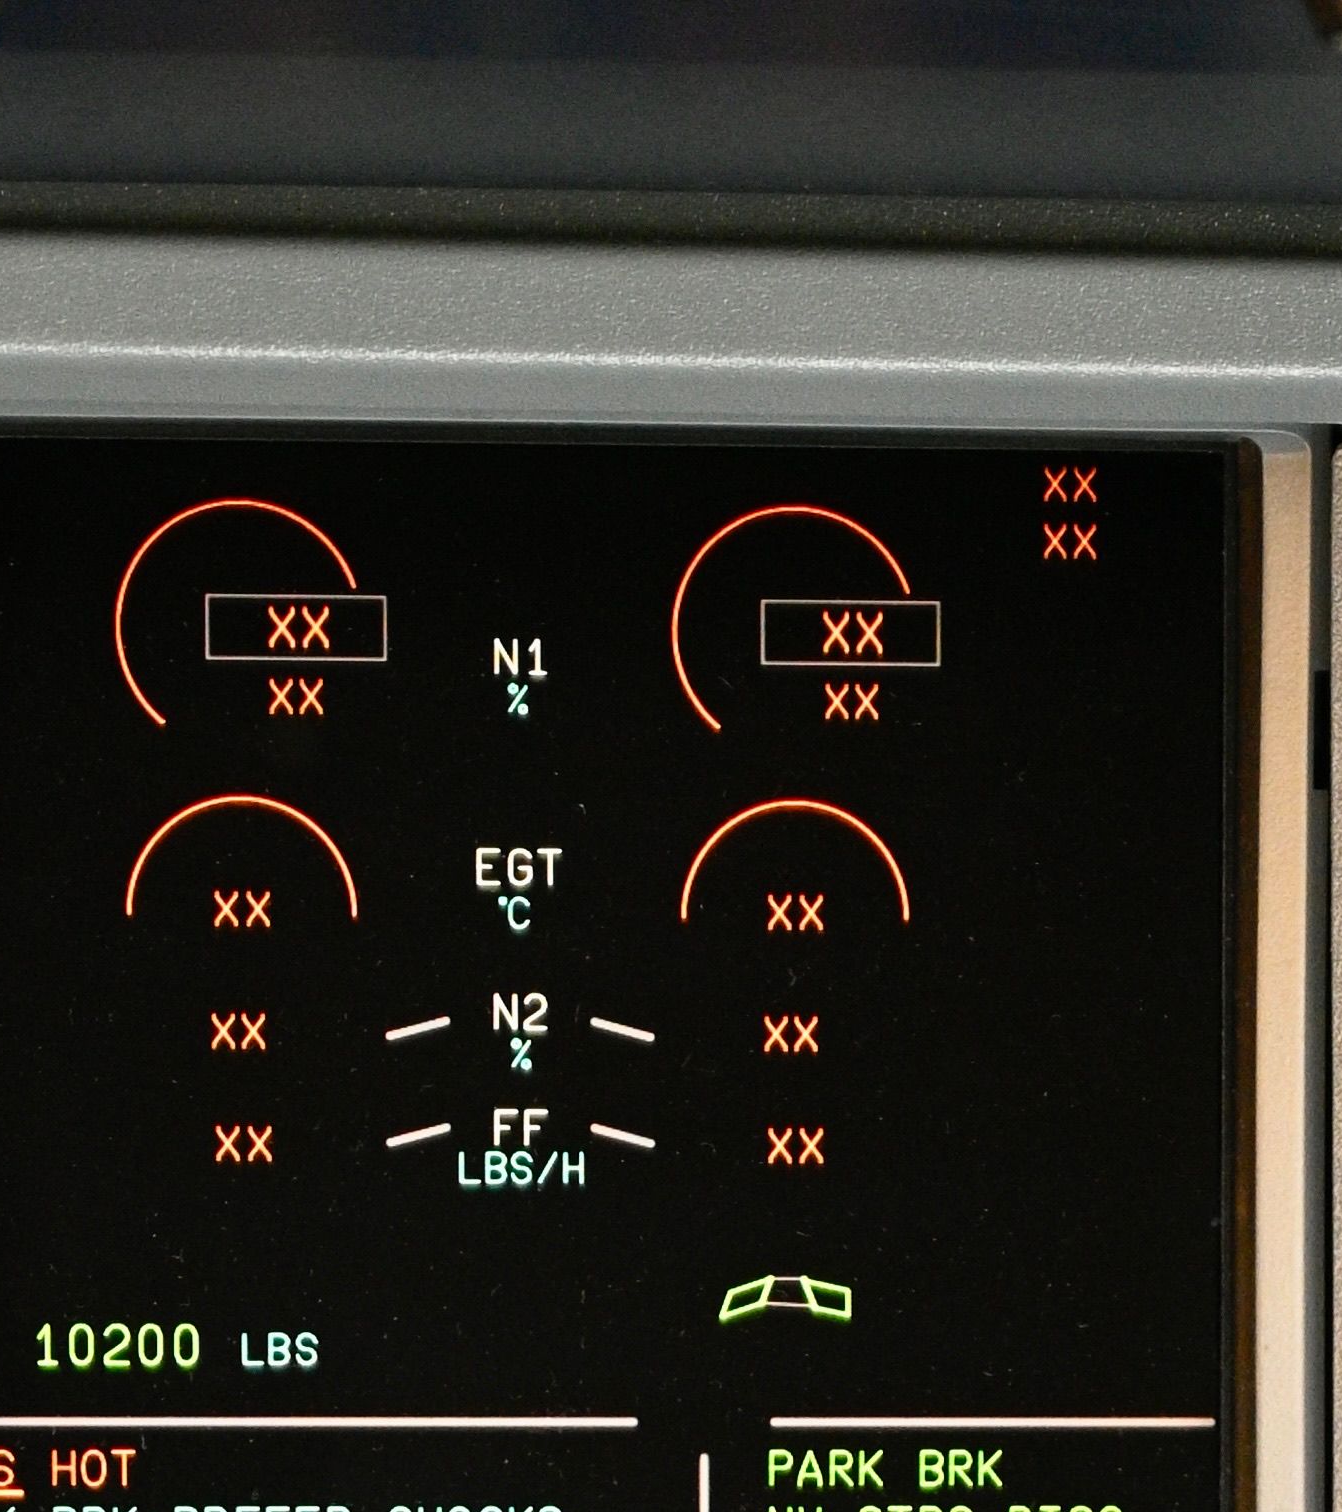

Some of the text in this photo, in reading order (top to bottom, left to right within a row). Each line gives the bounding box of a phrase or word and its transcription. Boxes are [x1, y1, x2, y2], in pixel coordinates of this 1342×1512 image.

[493, 637, 548, 679] N1
[475, 847, 563, 889] EGT
[492, 992, 549, 1035] N2
[493, 1108, 549, 1147] FF
[458, 1150, 585, 1187] LBS/H
[36, 1322, 200, 1369] 10200
[241, 1331, 319, 1368] LBS
[51, 1448, 137, 1490] HOT
[768, 1448, 1003, 1491] PARK BRK
